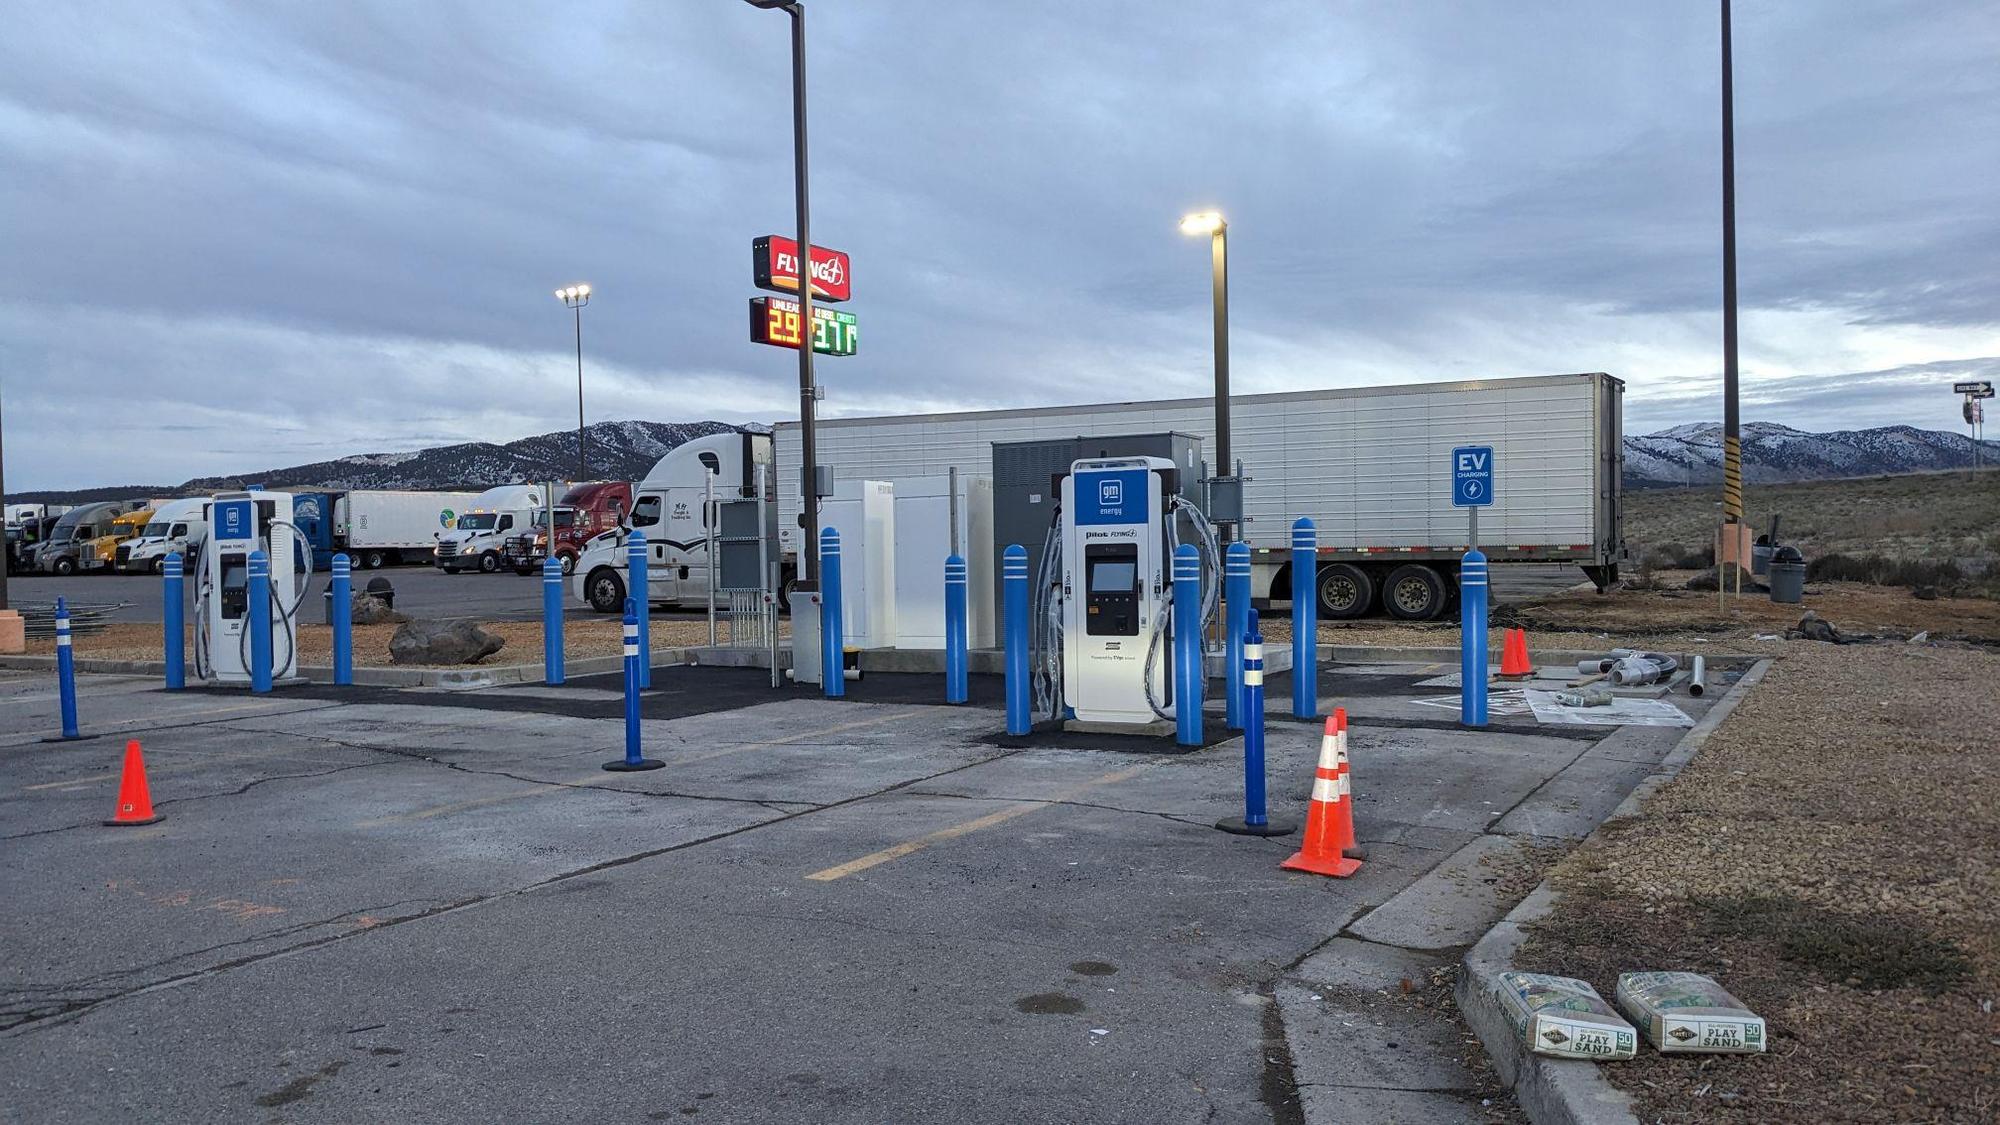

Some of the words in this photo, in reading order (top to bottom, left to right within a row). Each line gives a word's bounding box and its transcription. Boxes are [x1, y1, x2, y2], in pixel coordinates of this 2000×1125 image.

[776, 252, 829, 281] FLYNG
[1458, 453, 1487, 471] EV
[1103, 485, 1119, 499] gm
[1100, 508, 1122, 516] energy
[1085, 531, 1109, 540] pilot
[1707, 1029, 1738, 1038] PLAY
[1746, 1024, 1760, 1036] 50
[1579, 1033, 1610, 1045] PLAY
[1618, 1032, 1632, 1044] 50
[1703, 1038, 1741, 1048] SAND
[1574, 1042, 1612, 1055] SAND
